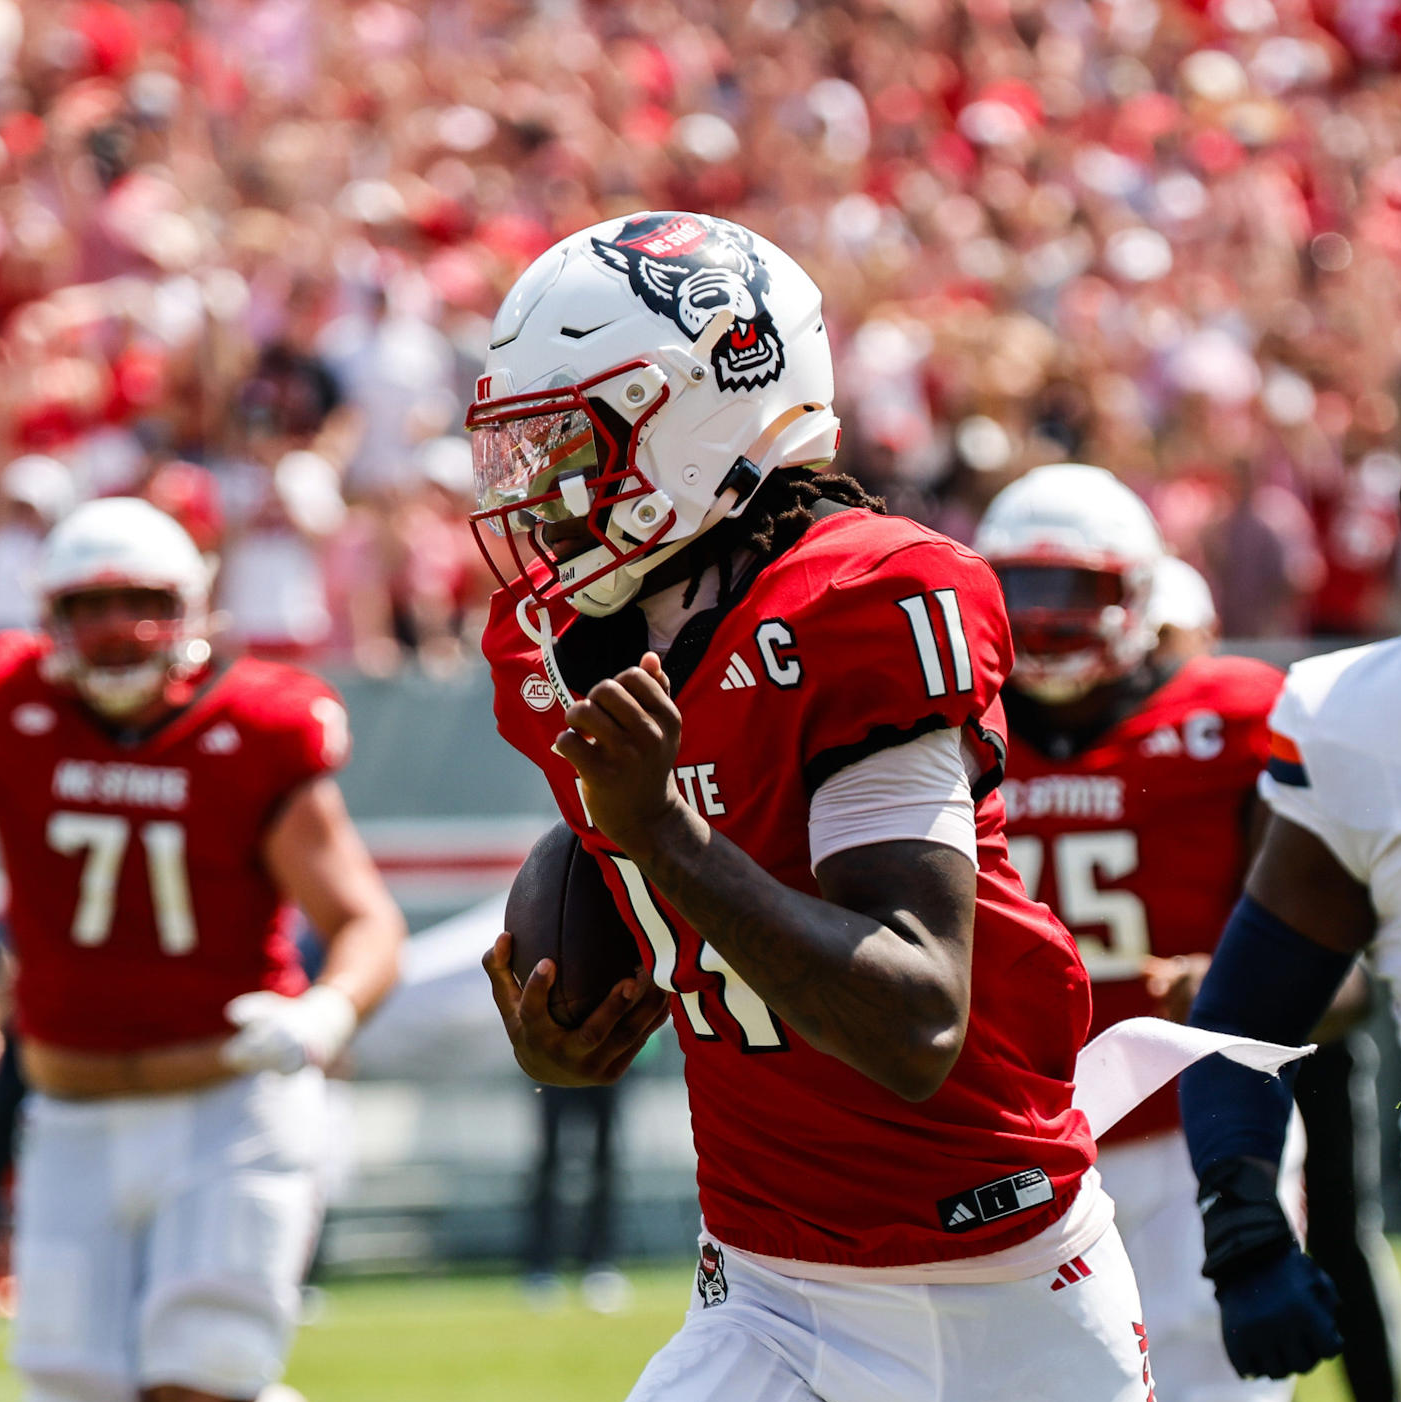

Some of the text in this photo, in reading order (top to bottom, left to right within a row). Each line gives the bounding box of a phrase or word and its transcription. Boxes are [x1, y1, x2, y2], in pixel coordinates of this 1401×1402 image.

[755, 618, 802, 688] C
[896, 588, 975, 699] 11
[526, 683, 551, 699] ACC
[1181, 708, 1225, 761] C
[46, 809, 200, 957] 71
